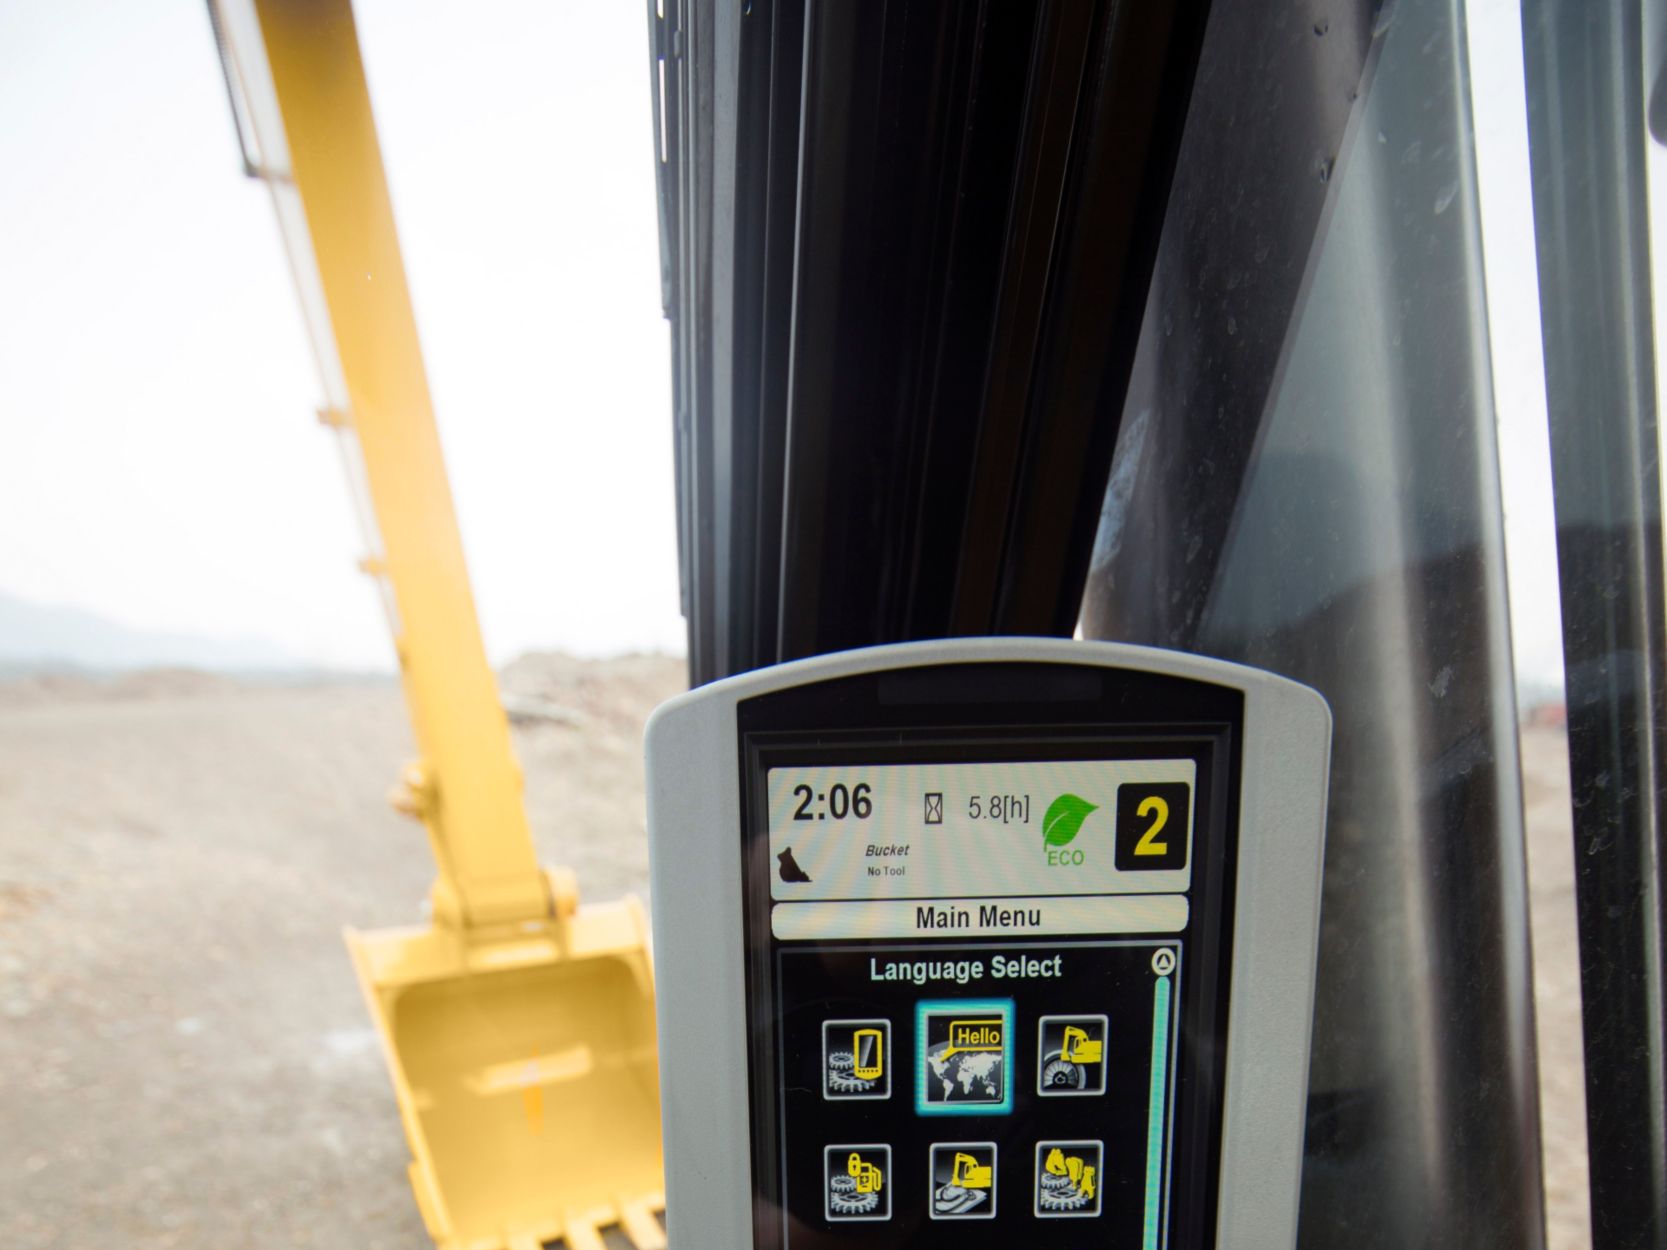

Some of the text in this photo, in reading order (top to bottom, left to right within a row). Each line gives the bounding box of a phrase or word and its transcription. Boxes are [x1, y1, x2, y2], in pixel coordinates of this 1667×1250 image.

[793, 783, 873, 820] 2:06
[969, 795, 1030, 824] 5.8[h]
[1133, 796, 1169, 856] 2
[865, 844, 910, 857] Bucket
[1048, 849, 1085, 866] ECO
[867, 866, 905, 876] No Tool
[916, 905, 1041, 929] Main Menu
[870, 955, 1062, 986] Language Select
[958, 1028, 1000, 1045] Hello
